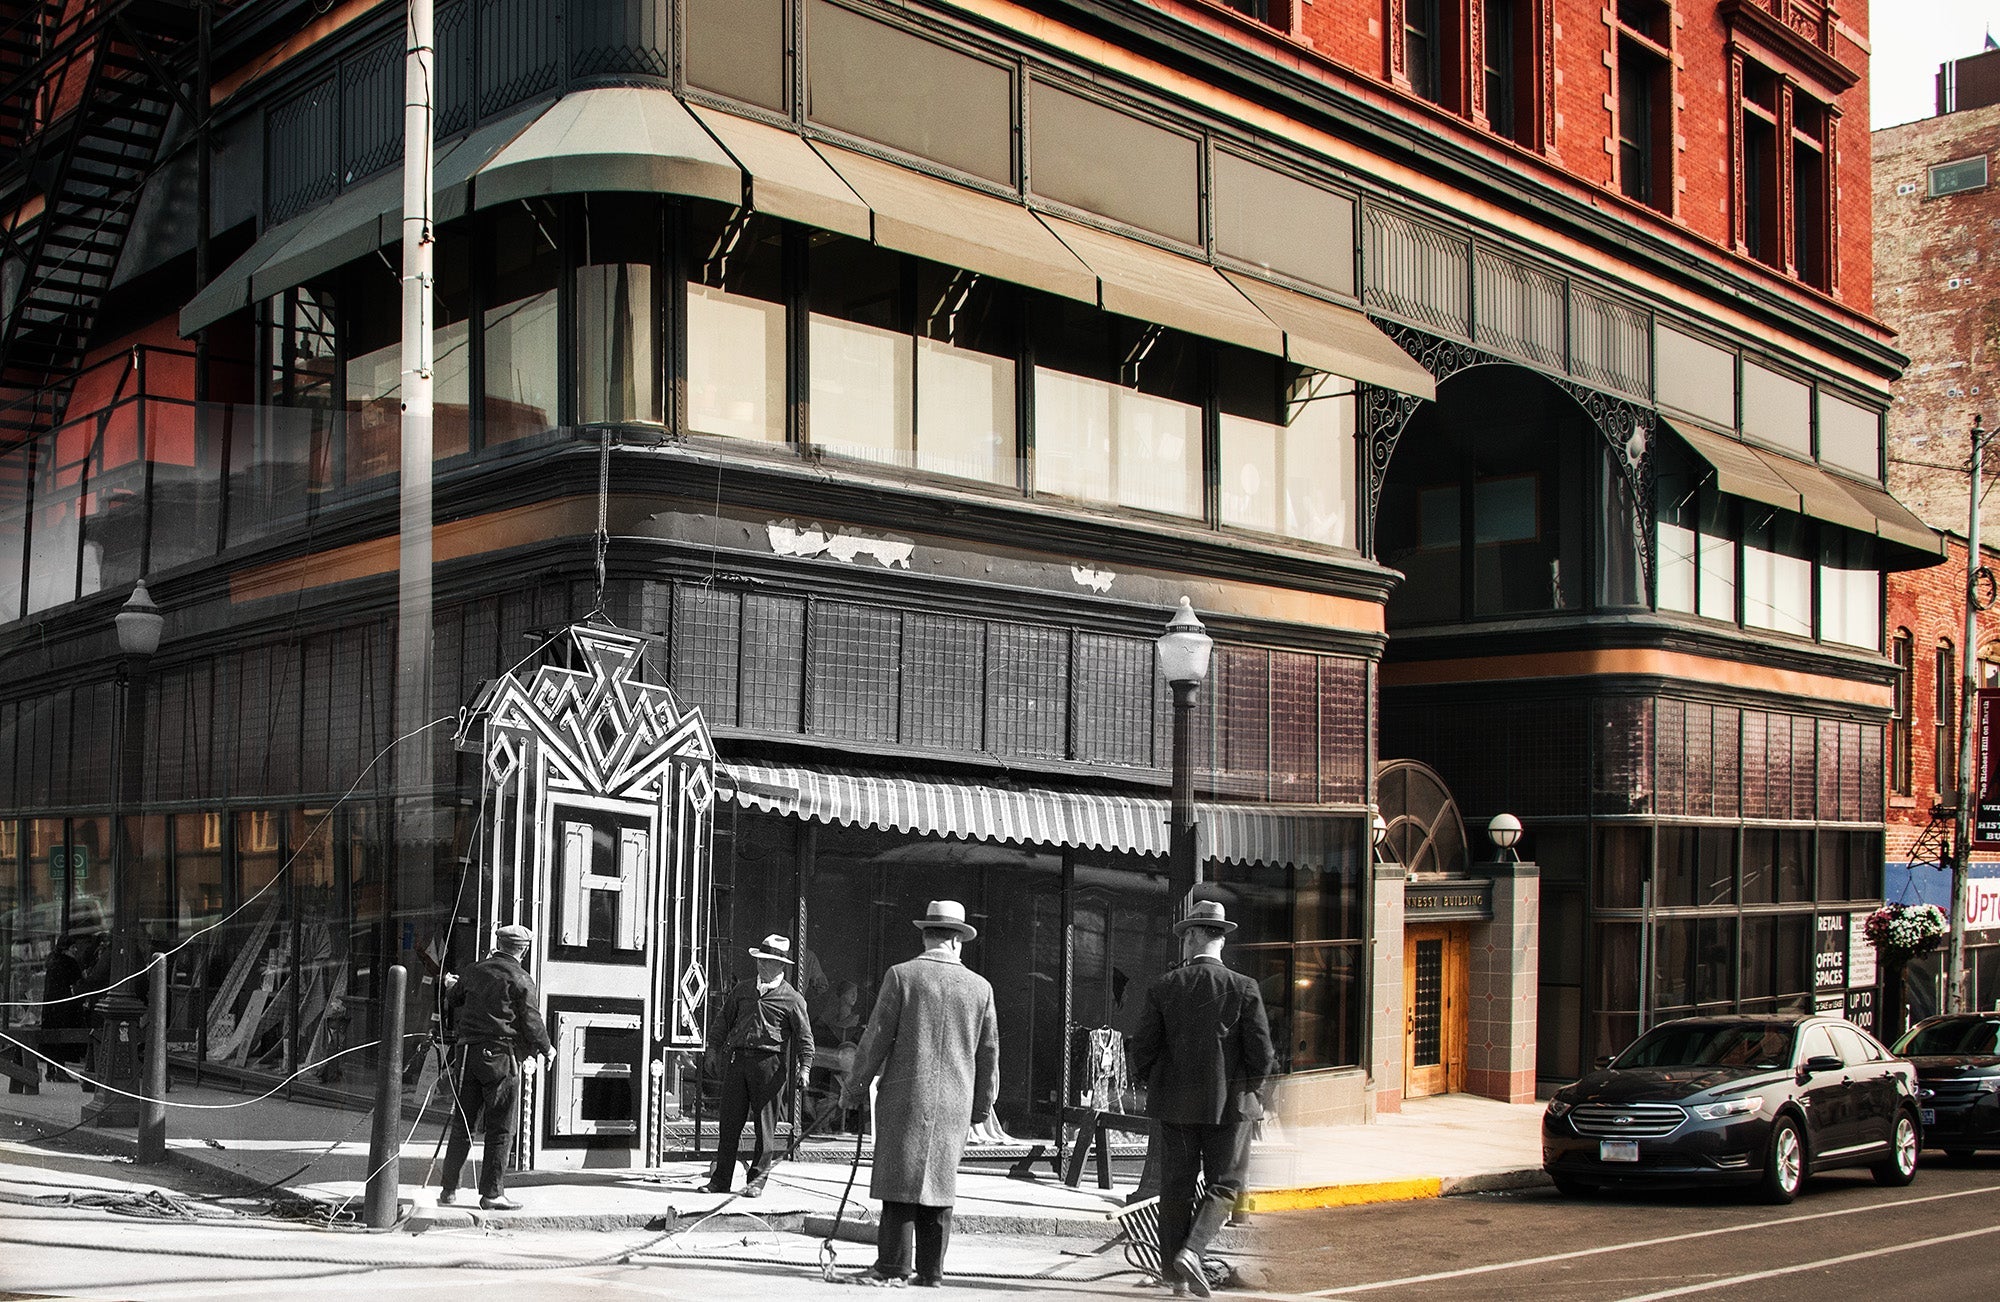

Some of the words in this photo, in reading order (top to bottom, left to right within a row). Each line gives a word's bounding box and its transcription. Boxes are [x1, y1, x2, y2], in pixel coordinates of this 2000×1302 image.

[1981, 756, 1989, 785] Richest
[1980, 786, 1988, 800] The
[1443, 895, 1482, 906] BUILDING
[1966, 885, 2000, 923] UPT
[1818, 916, 1843, 931] RETAIL
[1816, 951, 1843, 968] OFFICE
[1816, 969, 1843, 986] SPACES
[1849, 993, 1860, 1008] UP
[1861, 992, 1871, 1007] TO
[1848, 1011, 1872, 1027] 14000
